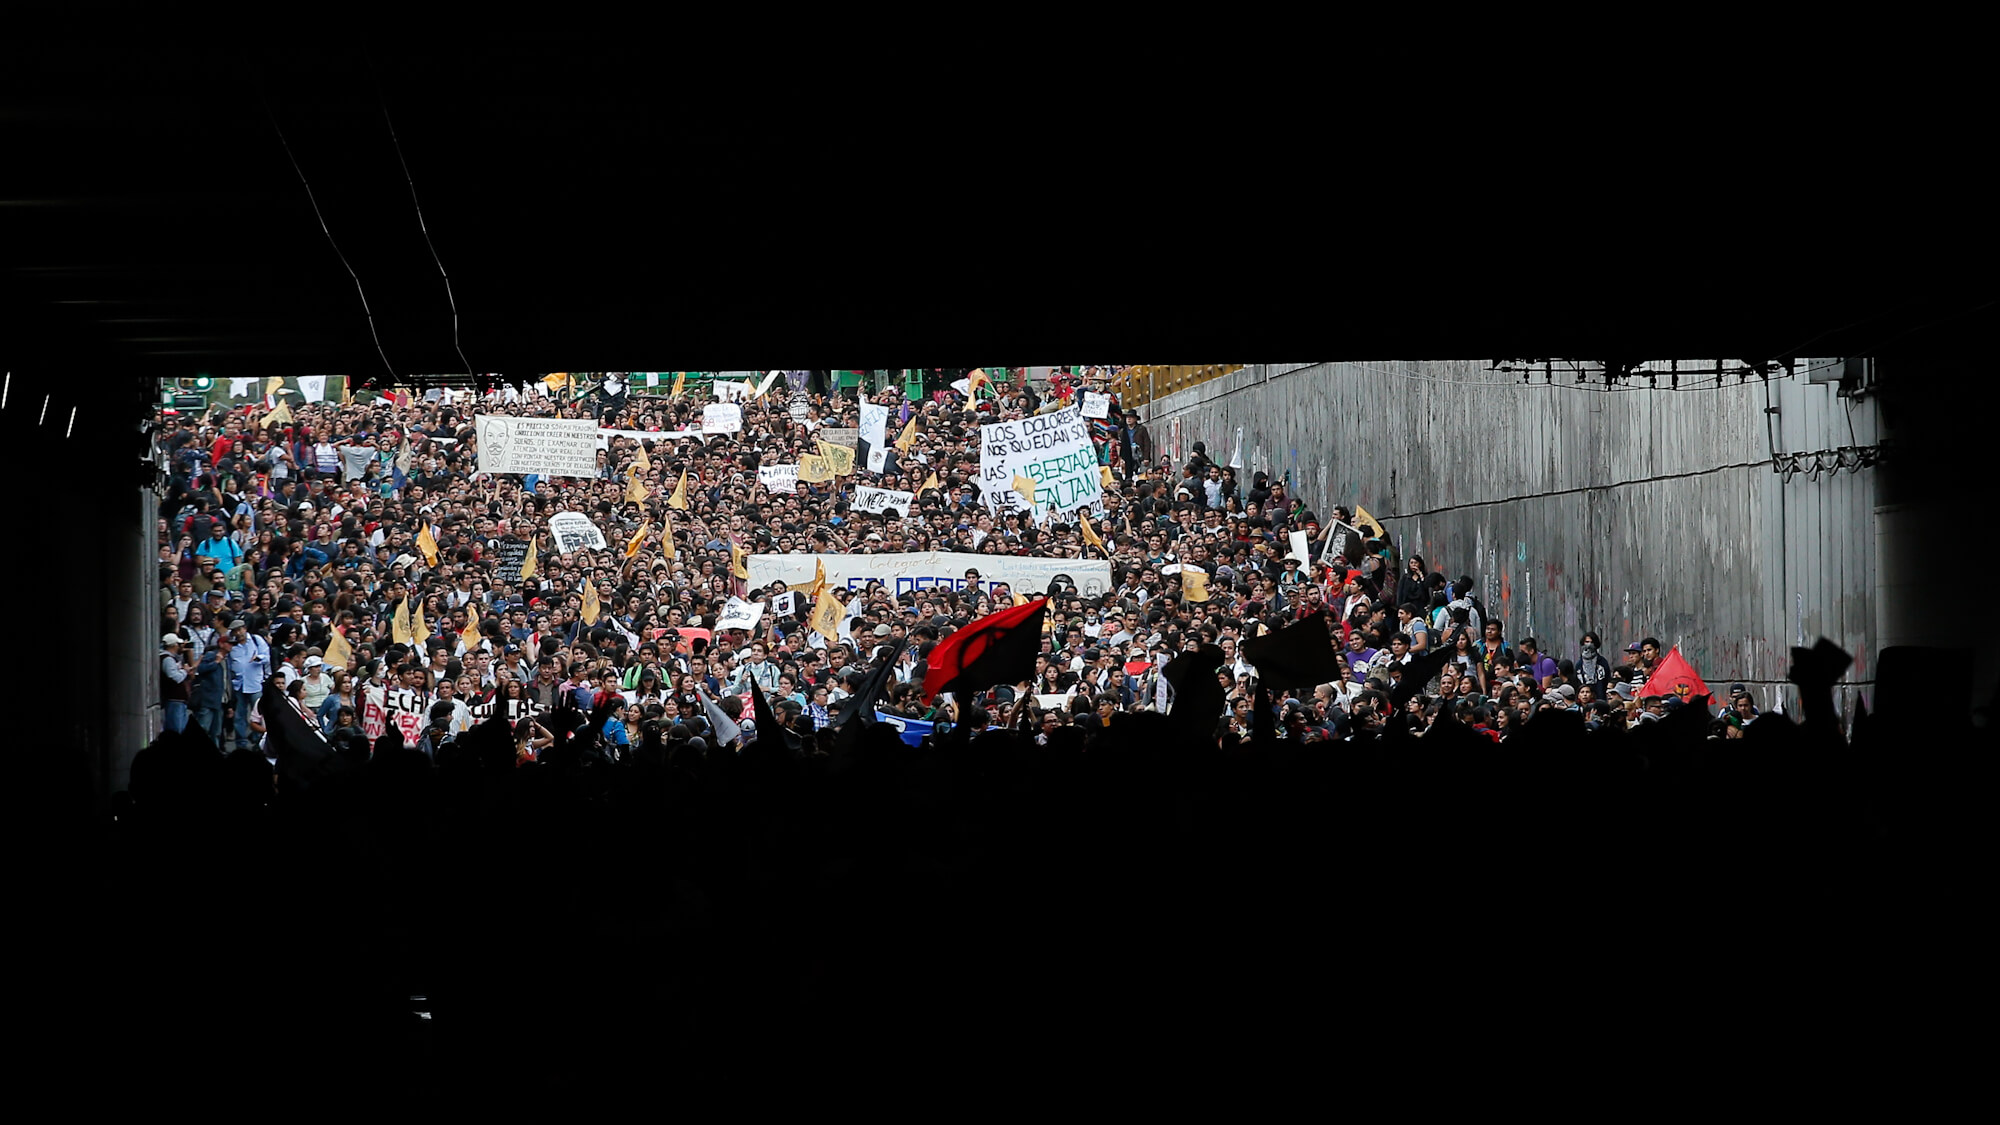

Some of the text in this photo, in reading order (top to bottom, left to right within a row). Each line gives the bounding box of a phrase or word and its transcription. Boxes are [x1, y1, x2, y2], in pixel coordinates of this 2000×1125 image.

[987, 425, 1016, 443] LOS
[1022, 408, 1074, 436] DOLORES
[548, 440, 578, 448] EXAMINAR
[987, 444, 1007, 456] NOS
[1010, 428, 1070, 453] QUEDAN
[985, 464, 1007, 481] LAS
[991, 490, 1017, 505] QUE
[1034, 470, 1096, 516] FALTAN
